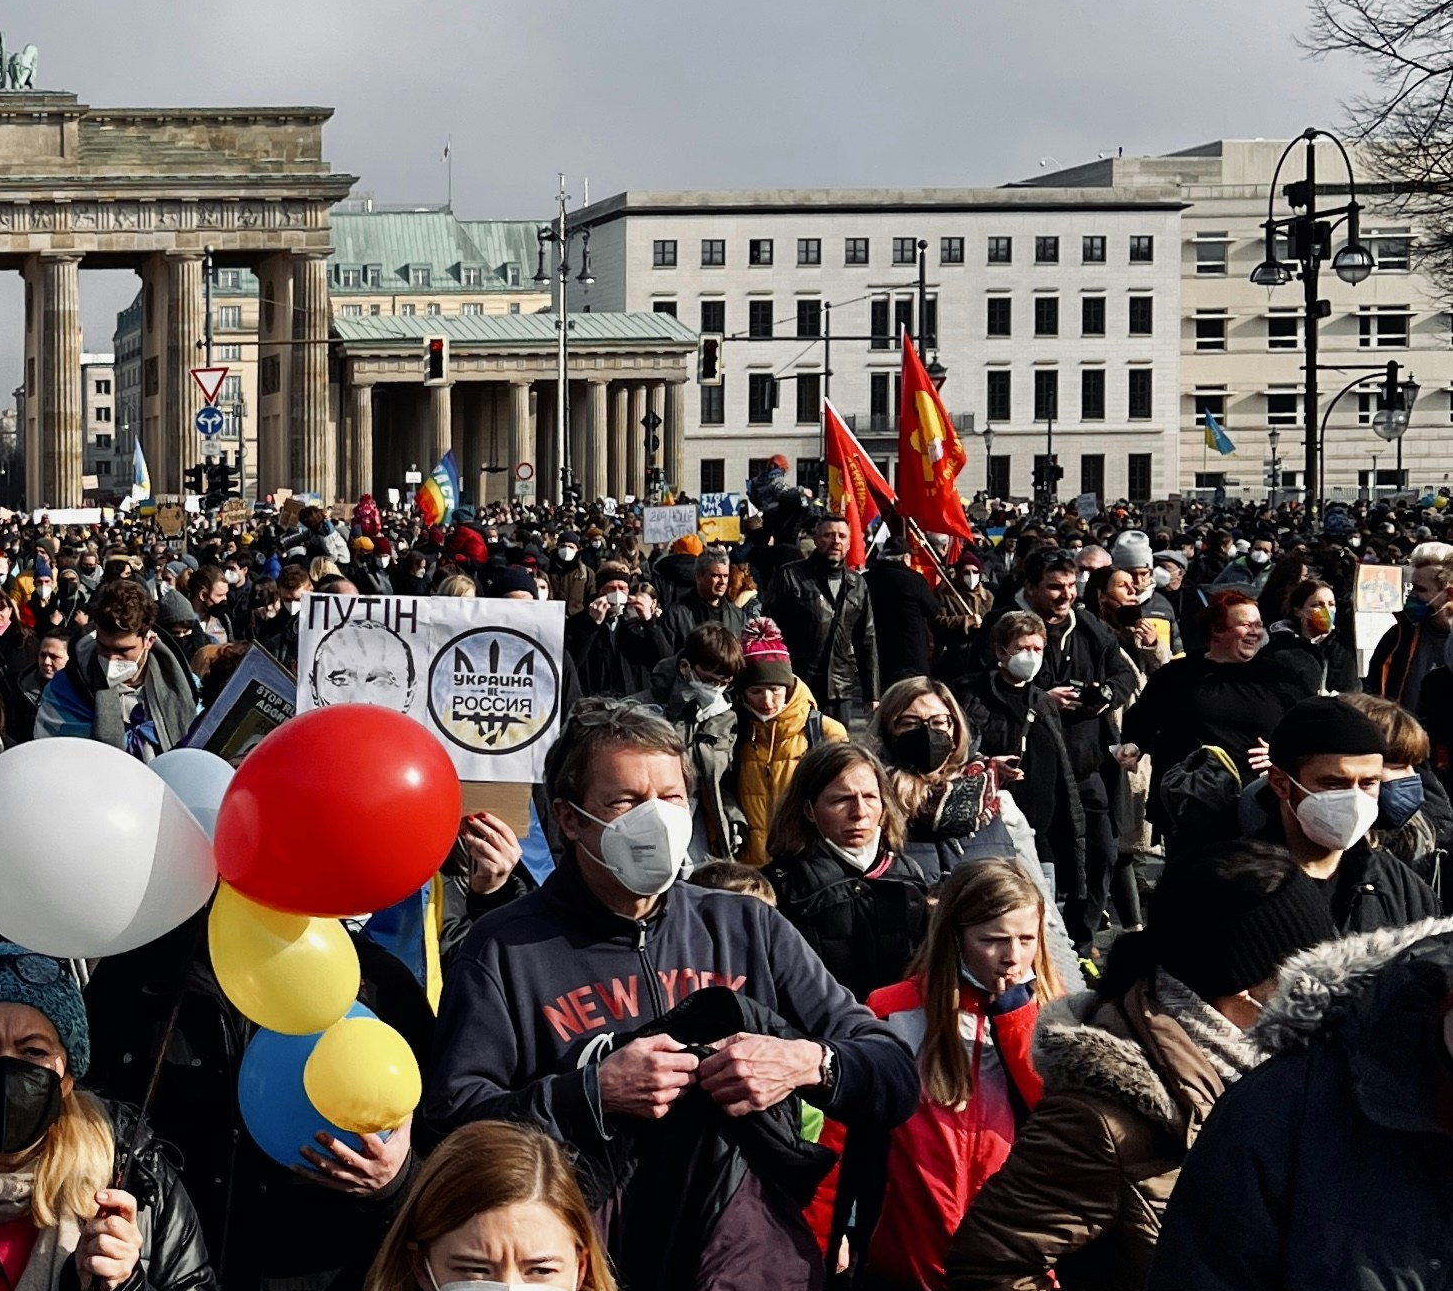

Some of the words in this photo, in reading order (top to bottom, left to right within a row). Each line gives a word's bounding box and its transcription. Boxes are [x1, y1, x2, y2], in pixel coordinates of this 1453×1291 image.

[701, 492, 728, 502] STOP
[701, 501, 722, 509] THE
[701, 508, 723, 517] WAR
[307, 595, 418, 635] ПУТІН
[453, 674, 533, 688] УКРАИНА
[256, 685, 283, 706] STOP
[452, 695, 532, 713] РОССИЯ
[542, 974, 640, 1043] NEW
